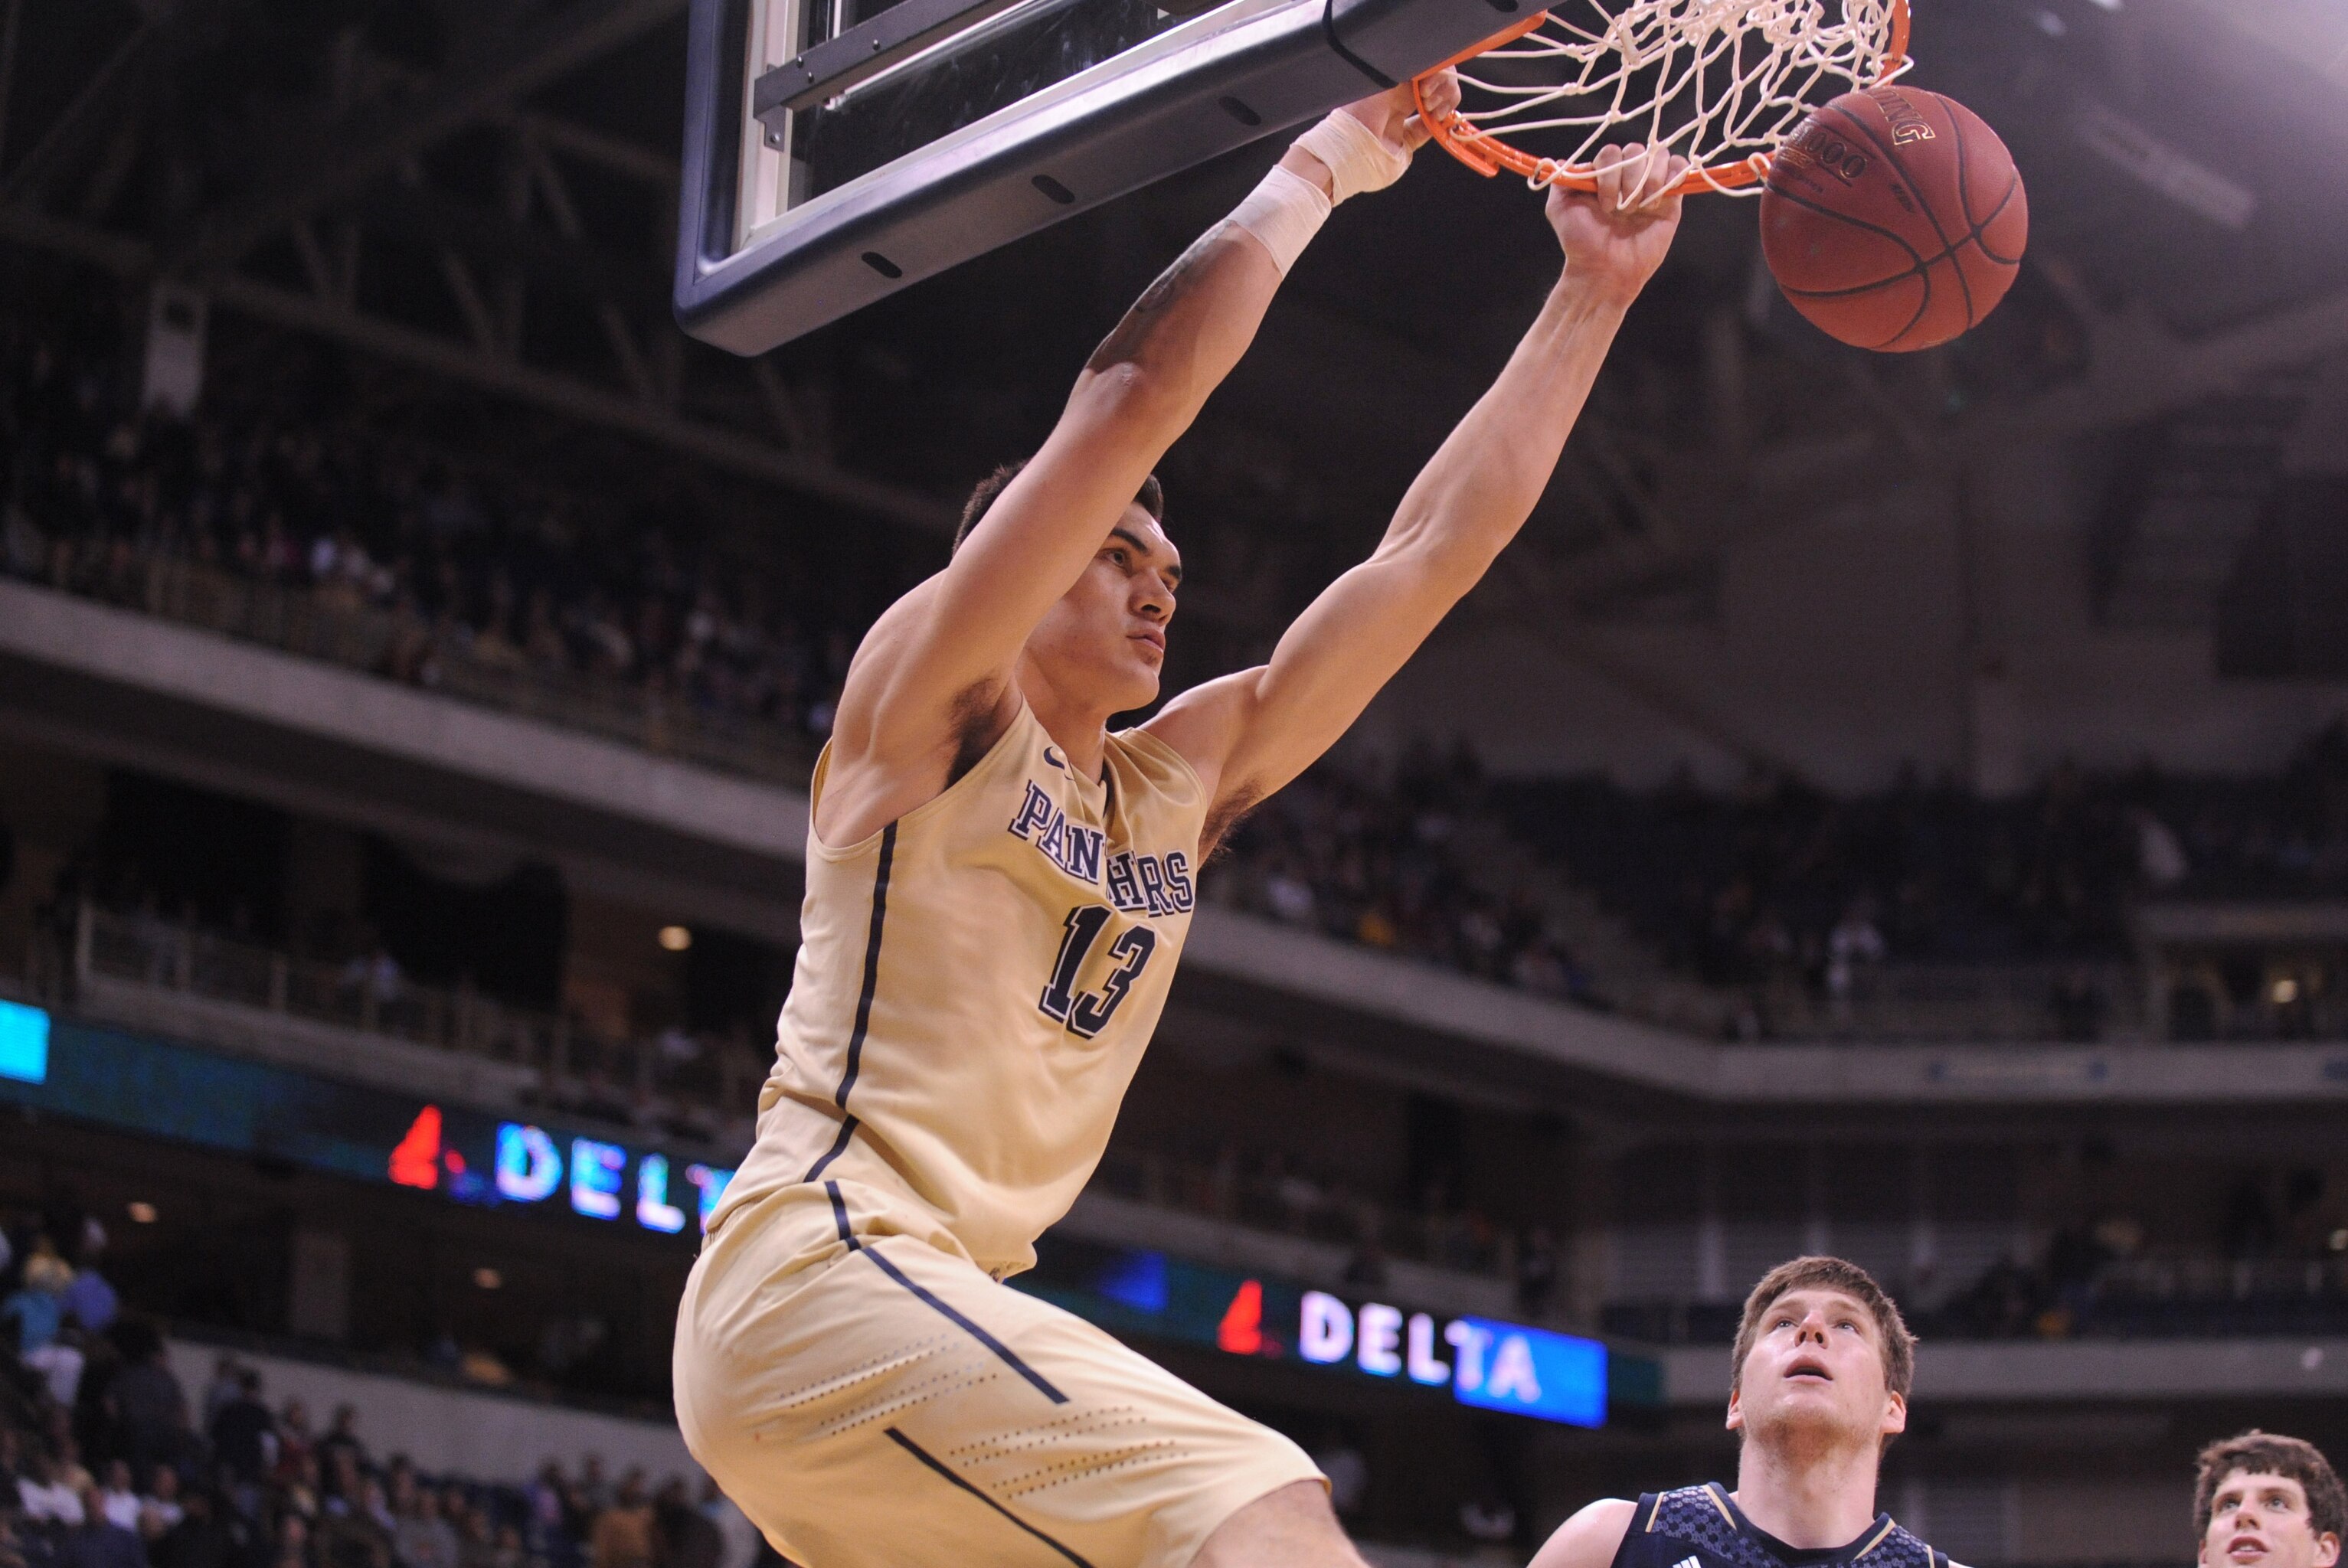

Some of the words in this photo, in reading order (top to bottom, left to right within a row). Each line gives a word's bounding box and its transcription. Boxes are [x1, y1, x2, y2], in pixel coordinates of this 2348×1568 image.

[1007, 779, 1196, 918] PANHRS
[1038, 903, 1156, 1040] 13
[495, 1120, 737, 1236] DELT
[1300, 1289, 1542, 1404] DELTA
